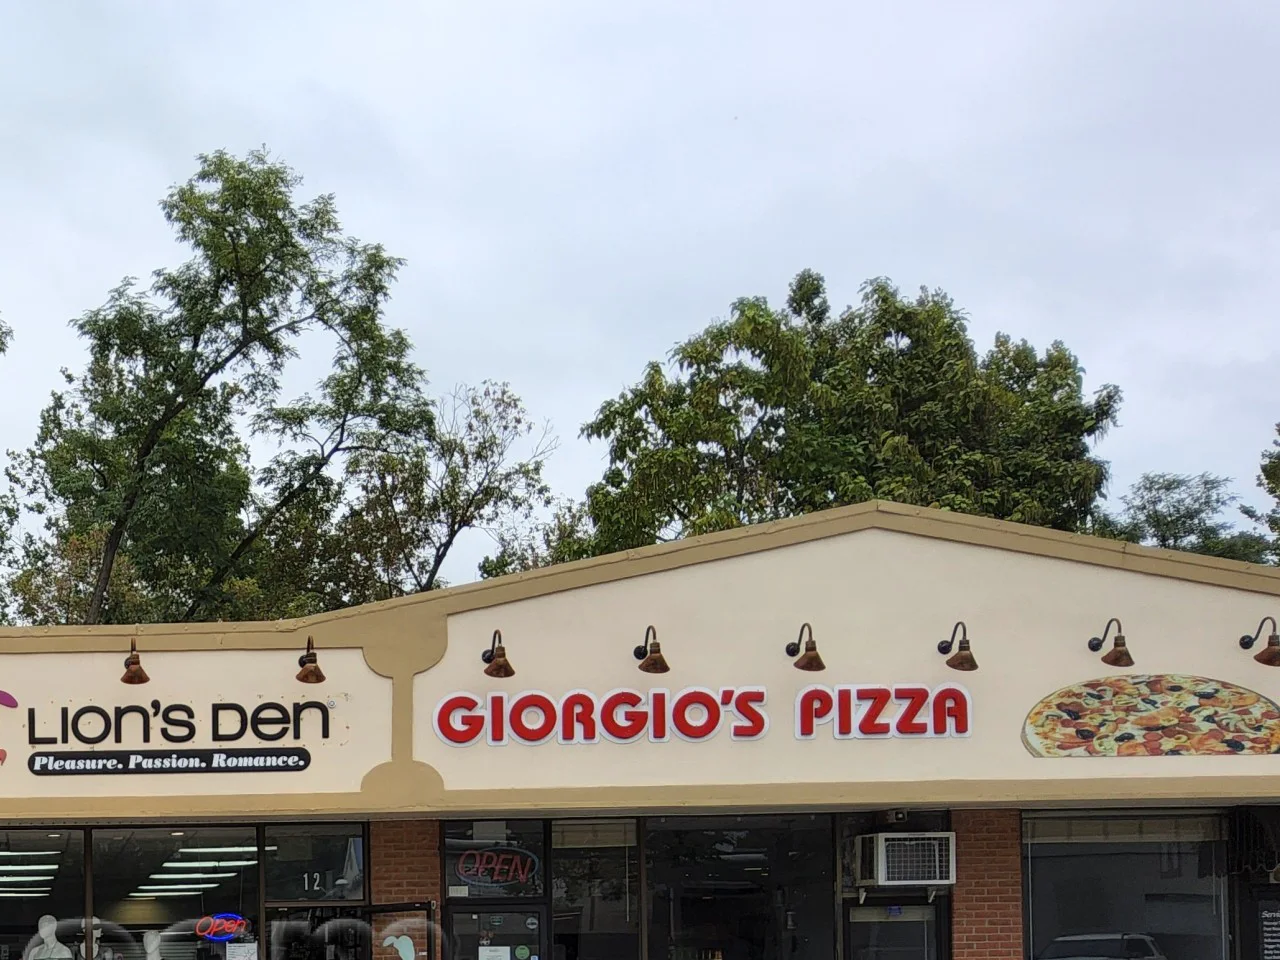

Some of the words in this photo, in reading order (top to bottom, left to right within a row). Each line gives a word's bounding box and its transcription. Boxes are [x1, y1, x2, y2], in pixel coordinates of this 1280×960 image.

[434, 685, 768, 745] GIORGIO'S
[797, 685, 970, 738] PIZZA
[33, 755, 123, 771] Pleasure.
[128, 754, 207, 769] Passion.
[212, 752, 305, 768] Romance.
[457, 849, 532, 884] OPEN
[303, 872, 320, 890] 12
[195, 915, 247, 937] Open
